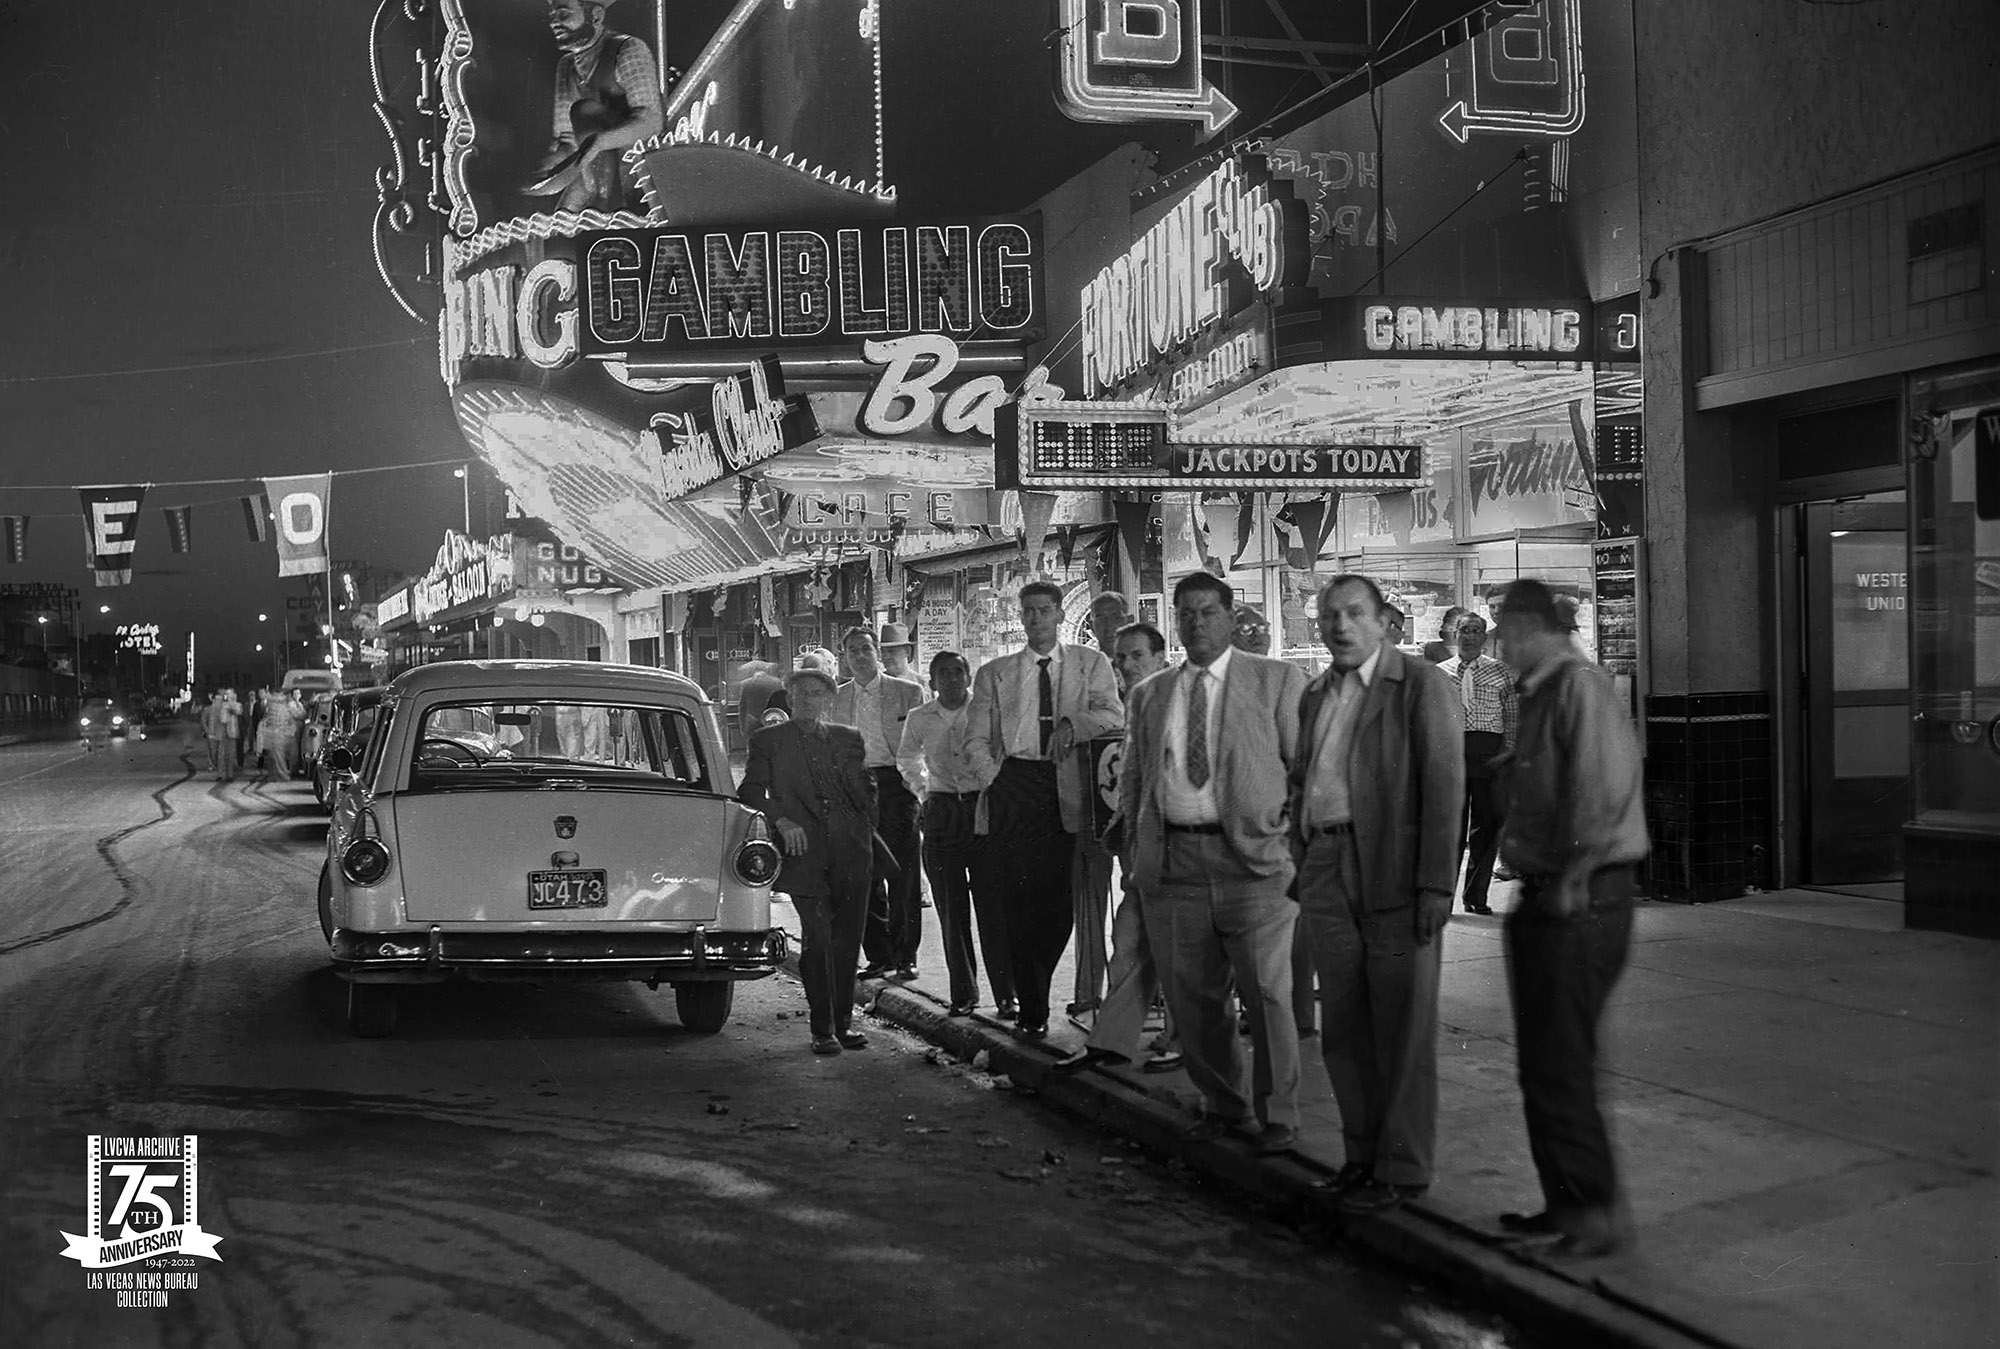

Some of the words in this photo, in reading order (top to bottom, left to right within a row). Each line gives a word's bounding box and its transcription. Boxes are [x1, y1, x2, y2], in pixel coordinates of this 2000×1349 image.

[587, 223, 1033, 344] GAMBLING
[1364, 305, 1580, 352] GAMBLING
[1181, 447, 1318, 475] JACKPOTS
[1327, 447, 1411, 474] TODAY
[279, 492, 325, 546] O
[798, 490, 955, 526] CAFE
[92, 500, 137, 556] E
[1856, 572, 1908, 588] WESTE
[932, 608, 948, 617] DAY
[1867, 596, 1906, 611] UNIO
[539, 873, 568, 881] UTAH
